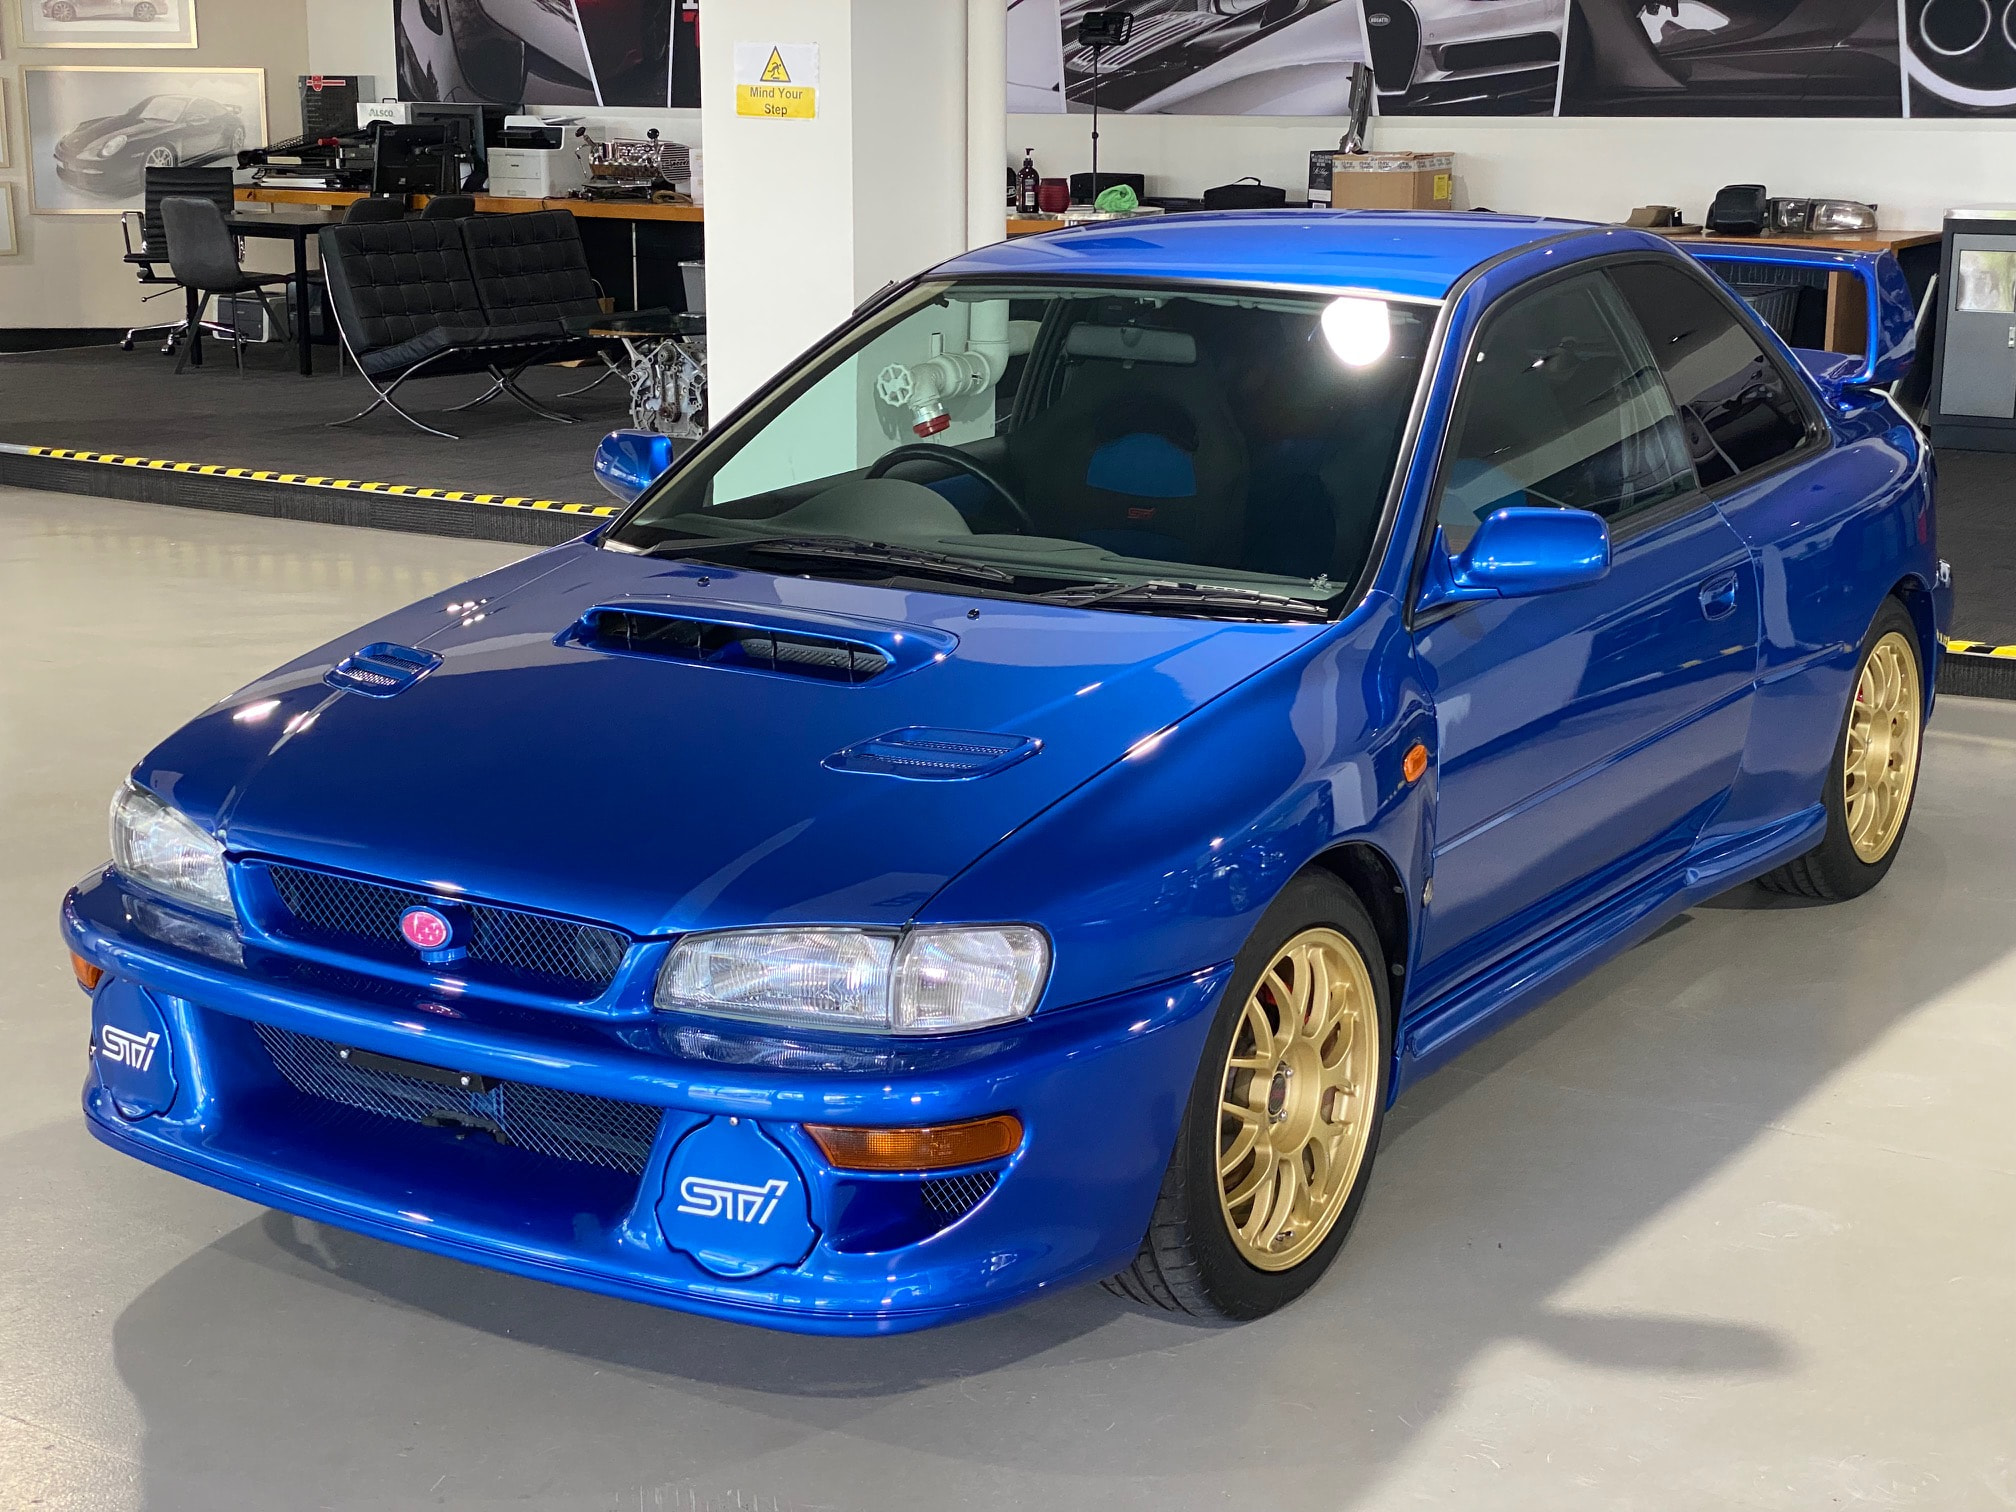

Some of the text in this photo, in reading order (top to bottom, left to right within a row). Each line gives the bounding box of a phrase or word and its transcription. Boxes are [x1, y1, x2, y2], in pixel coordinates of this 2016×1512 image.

[749, 86, 803, 99] Mind Your
[764, 103, 788, 117] Step
